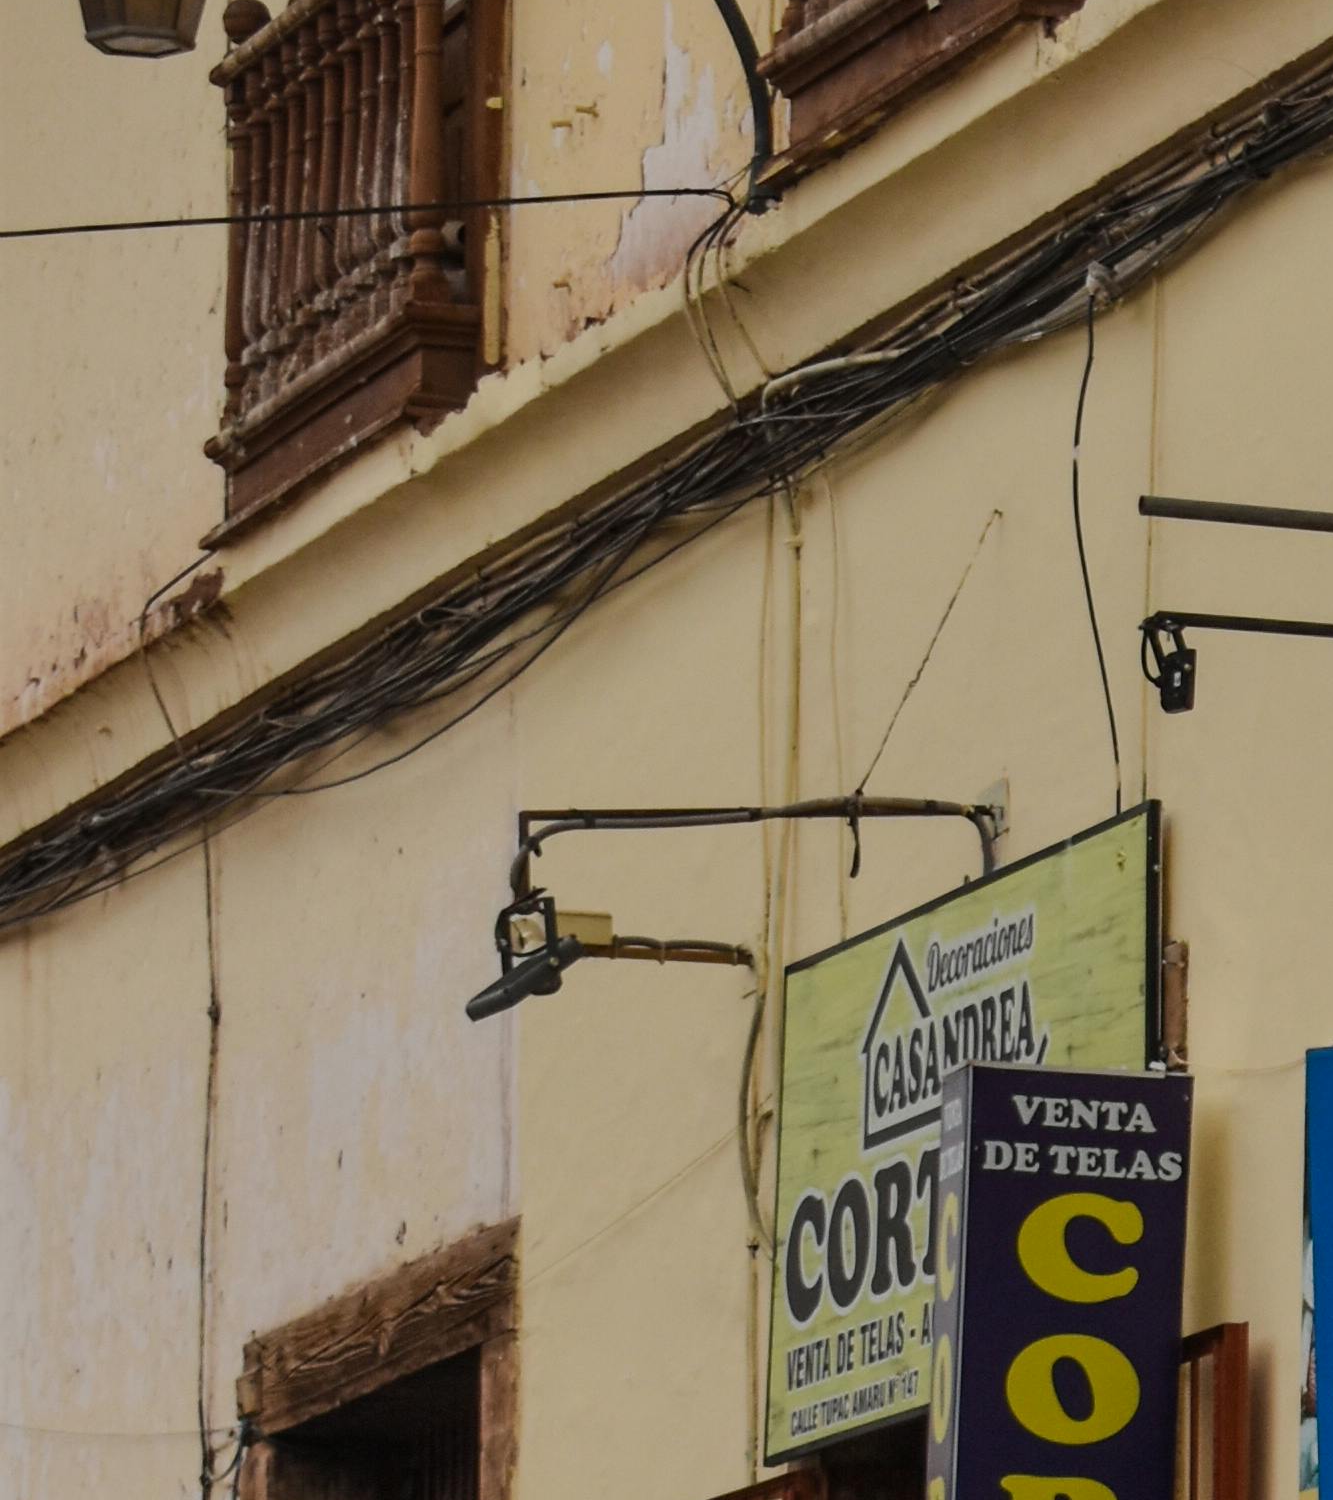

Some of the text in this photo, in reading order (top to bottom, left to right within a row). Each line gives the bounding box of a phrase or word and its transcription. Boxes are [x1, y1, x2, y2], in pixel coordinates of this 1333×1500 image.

[928, 913, 1035, 994] Decoraciones
[872, 981, 1036, 1118] CASANDREA
[1012, 1095, 1157, 1135] VENTA
[983, 1138, 1038, 1175] DE
[1049, 1143, 1183, 1182] TELAS
[787, 1338, 832, 1392] VENTA
[836, 1329, 856, 1375] DE
[860, 1311, 905, 1367] TELAS
[791, 1403, 818, 1437] CALLE
[821, 1393, 850, 1426] TUPAC
